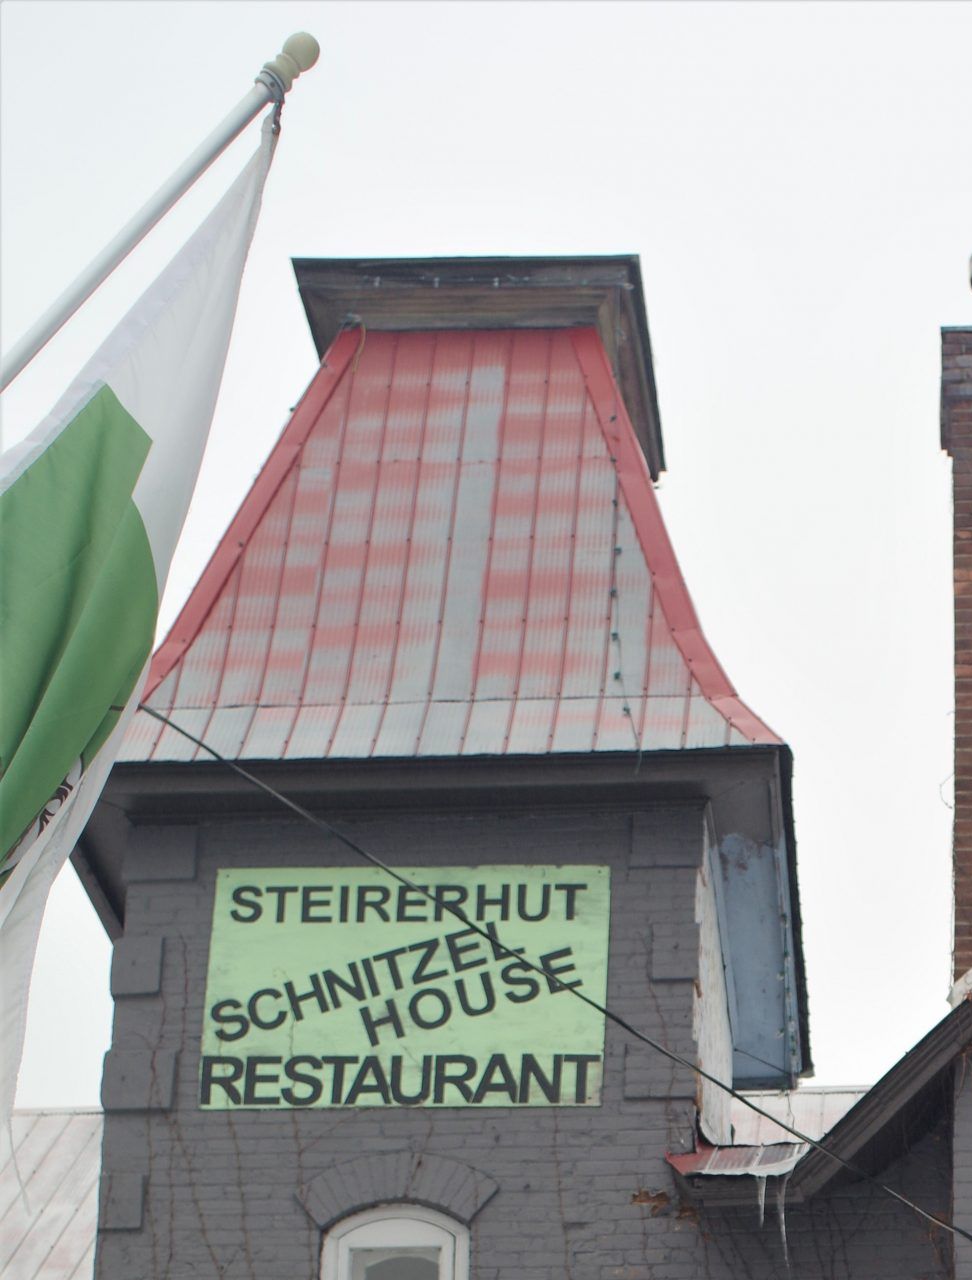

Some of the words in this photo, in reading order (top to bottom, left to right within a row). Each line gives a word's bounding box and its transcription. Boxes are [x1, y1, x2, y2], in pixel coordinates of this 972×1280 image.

[230, 883, 588, 924] STEIRERHUT
[210, 921, 525, 1042] SCHNITZEL
[359, 946, 584, 1047] HOUSE
[200, 1053, 601, 1106] RESTAURANT
